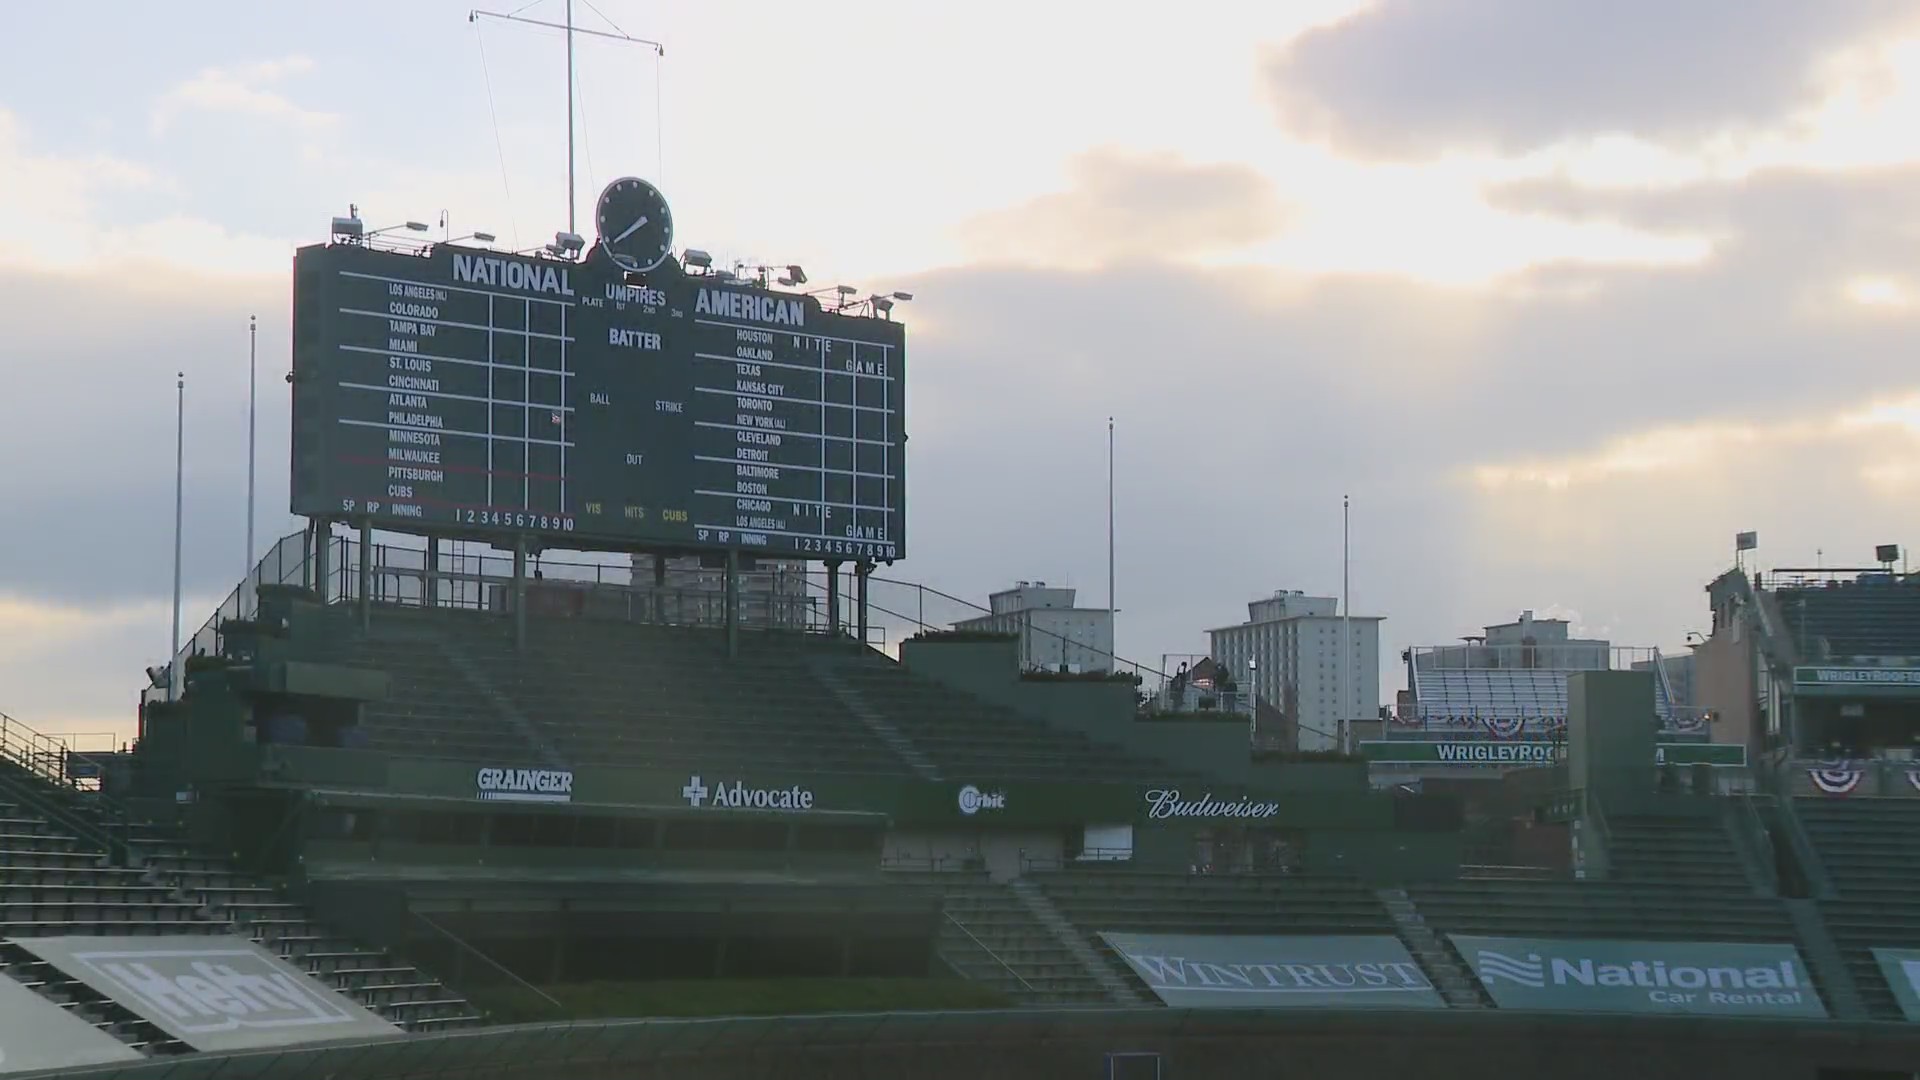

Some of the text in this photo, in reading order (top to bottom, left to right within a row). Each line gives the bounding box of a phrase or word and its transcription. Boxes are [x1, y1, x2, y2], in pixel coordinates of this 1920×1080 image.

[453, 254, 574, 296] NATIONAL
[389, 283, 404, 296] LOS
[404, 285, 435, 300] ANGELES
[605, 283, 666, 306] UMPIRES
[389, 301, 439, 319] COLORADO
[582, 296, 603, 308] PLATE
[695, 288, 805, 326] AMERICAN
[389, 320, 437, 337] TAMPA BAY
[609, 328, 661, 350] BATTER
[736, 329, 773, 345] HOUSTON
[389, 338, 418, 353] MIAMI
[736, 346, 774, 361] OAKLAND
[390, 356, 432, 373] ST. LOUIS
[736, 363, 761, 377] TEXAS
[389, 374, 439, 392] CINCINNATI
[736, 380, 784, 396] KANSAS CITY
[389, 393, 427, 409] ATLANTA
[590, 392, 683, 413] BALL STRIKE
[737, 397, 773, 412] TORONTO
[389, 411, 443, 428] PHILADELPHIA
[737, 414, 754, 426] NEW
[755, 415, 774, 429] YORK
[389, 430, 440, 446] MINNESOTA
[737, 431, 781, 446] CLEVELAND
[388, 448, 440, 464] MILWAUKEE
[626, 453, 643, 465] OUT
[737, 448, 768, 462] DETROIT
[388, 466, 443, 482] PITTSBURGH
[736, 465, 779, 480] BALTIMORE
[388, 484, 413, 498] CUBS
[737, 481, 767, 495] BOSTON
[343, 499, 422, 517] SP RP INNING
[586, 503, 601, 515] VIS
[624, 506, 644, 519] HITS
[736, 498, 771, 513] CHICAGO
[456, 508, 574, 531] 1 2 3 4 5 6 7 8 9 10
[662, 509, 688, 522] CUBS
[736, 516, 748, 528] LOS
[698, 529, 767, 546] SP RP INNING
[794, 538, 896, 558] 1 2 3 4 5 6 7 8 9 10
[477, 768, 573, 793] GRAINGER
[712, 781, 813, 809] Advocate
[959, 785, 1005, 814] Orbit
[1145, 790, 1279, 819] Budweiser
[1127, 955, 1421, 987] WINTRUST
[1551, 958, 1797, 990] National
[103, 961, 327, 1018] Hefty
[1648, 990, 1801, 1005] Car Rental
